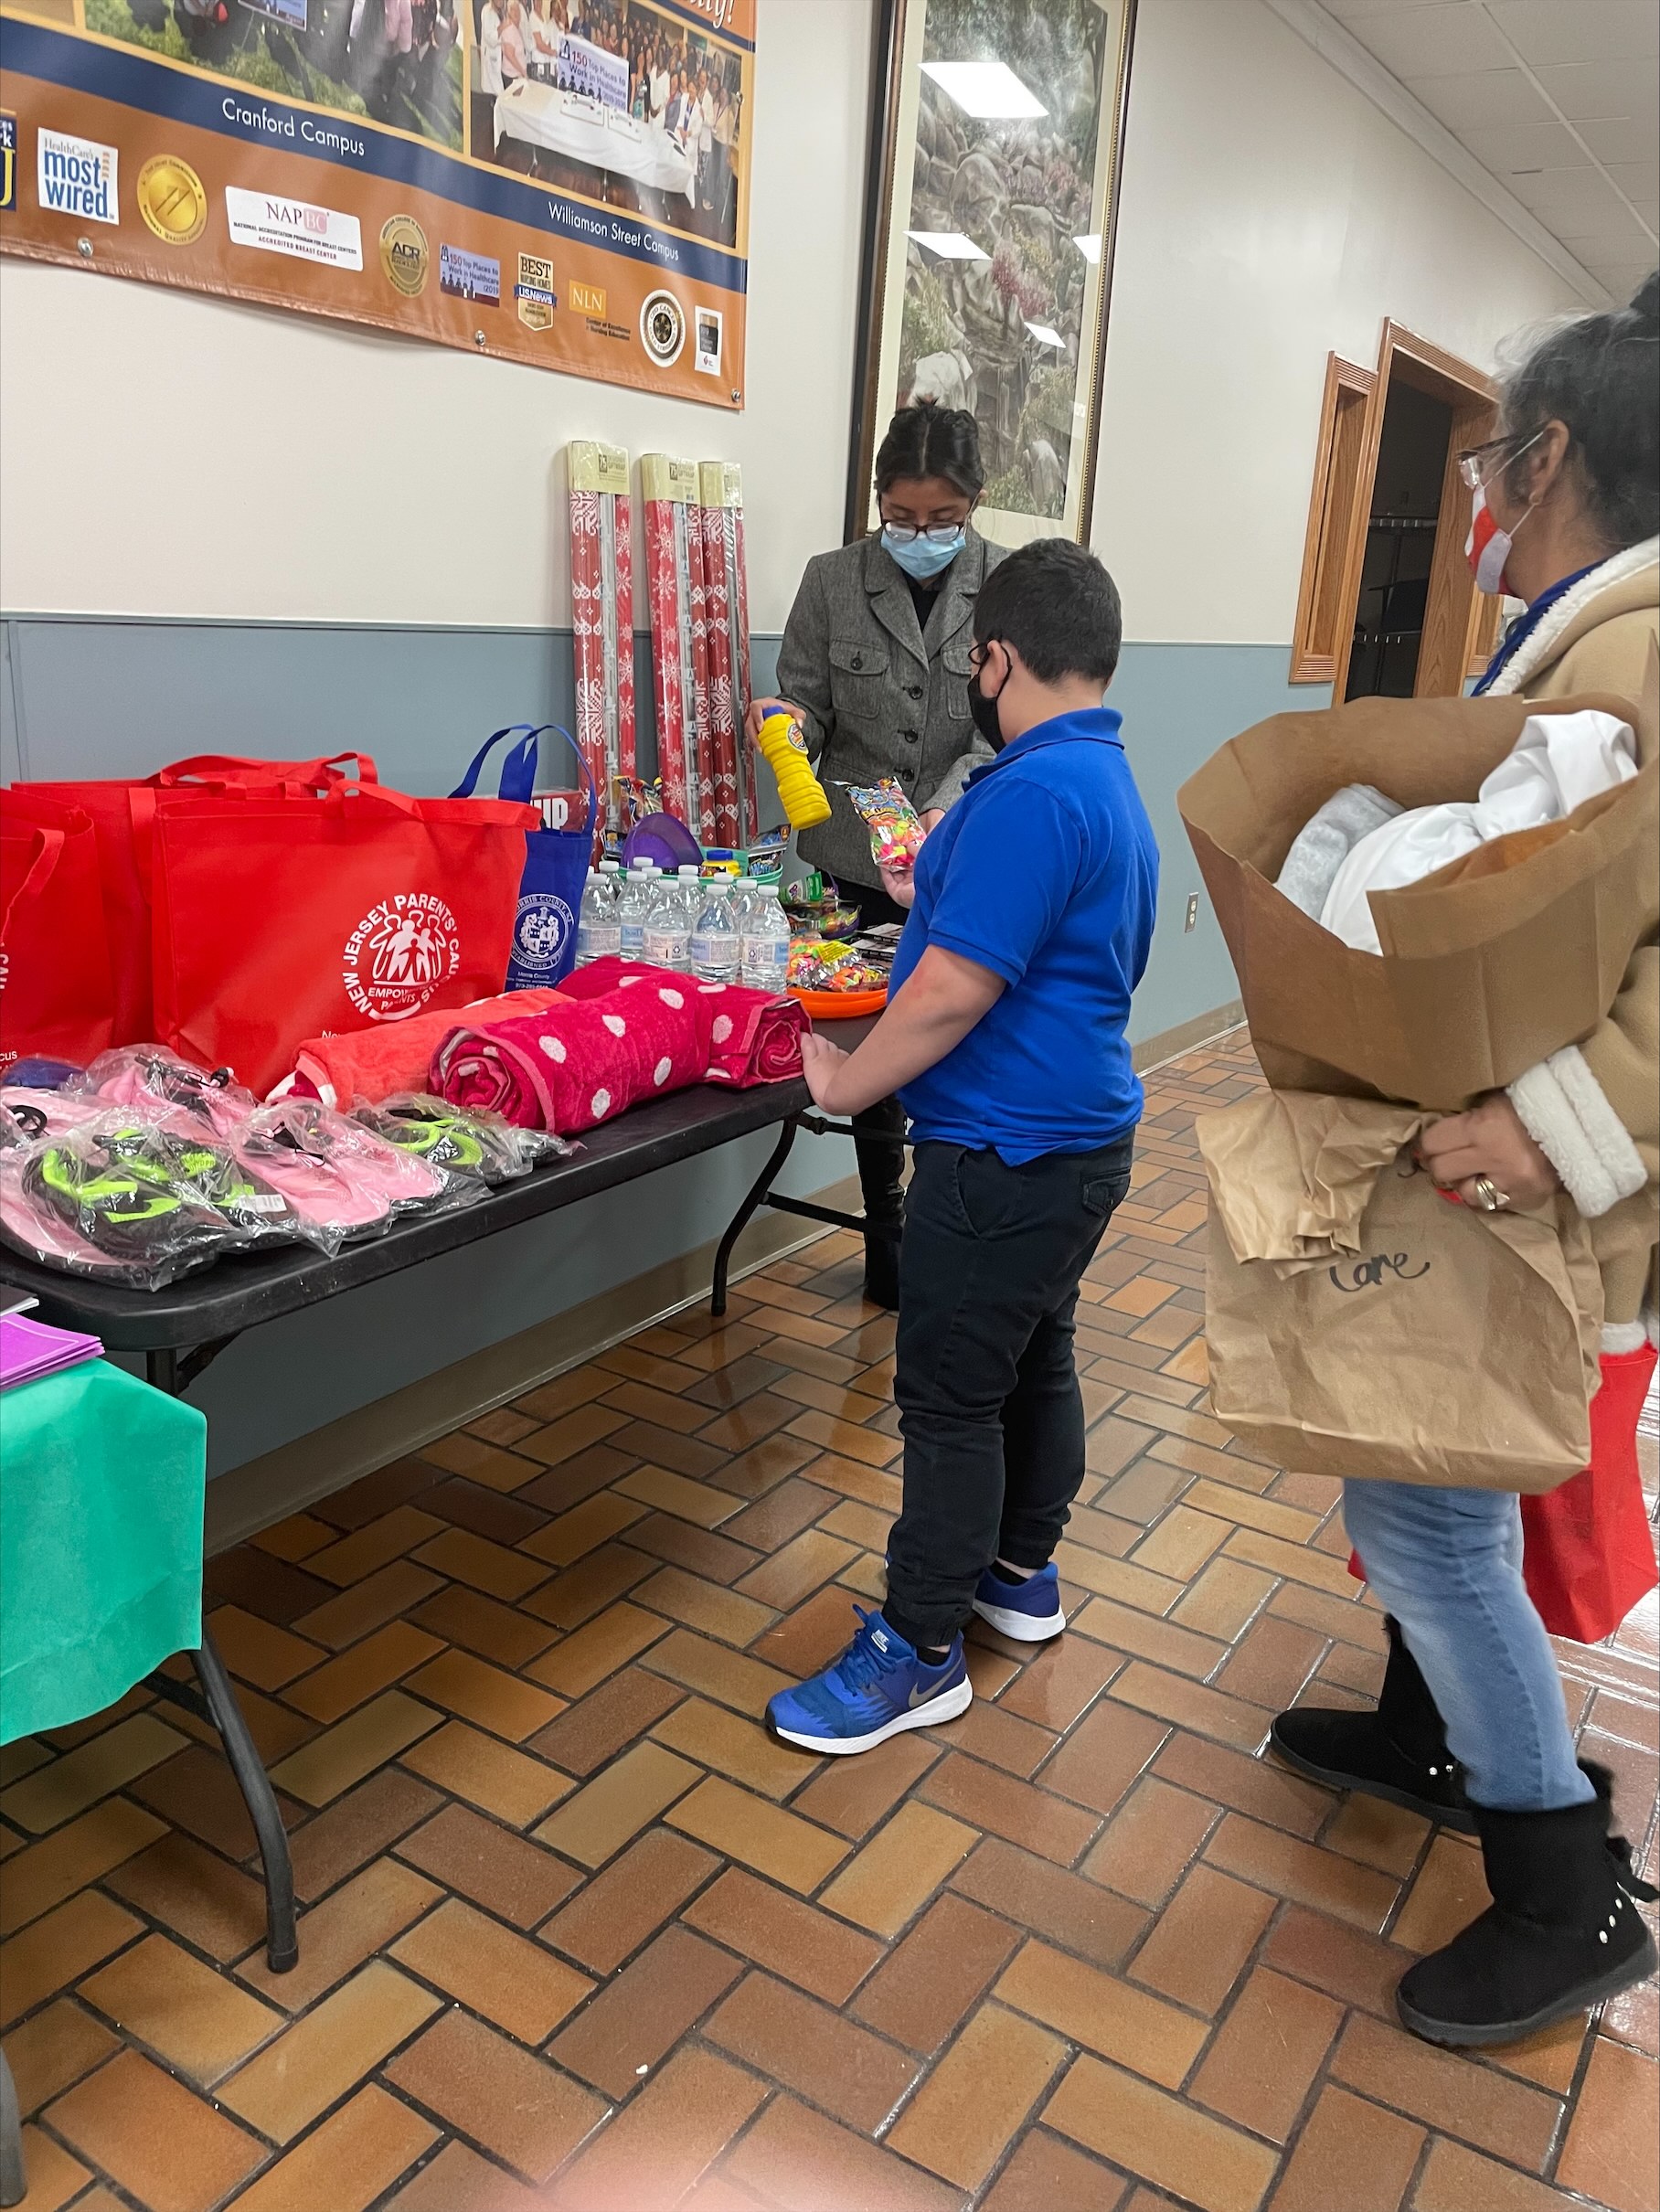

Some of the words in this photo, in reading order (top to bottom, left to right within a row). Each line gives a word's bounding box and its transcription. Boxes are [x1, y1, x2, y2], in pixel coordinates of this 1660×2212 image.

[569, 62, 588, 79] Work
[222, 98, 294, 137] Cranford
[301, 121, 365, 156] Campus
[44, 150, 101, 189] most
[45, 178, 108, 218] wired
[548, 201, 607, 237] Williamson
[611, 222, 641, 248] Street
[644, 233, 679, 261] Campus
[258, 235, 293, 250] ACCREDITED
[295, 243, 315, 256] BREAST
[316, 249, 337, 261] CENTER
[392, 241, 420, 261] ACR
[450, 253, 463, 266] 150
[448, 264, 463, 276] Work
[520, 256, 551, 279] BEST
[572, 287, 603, 313] NLN
[343, 900, 389, 966] JERSEY
[342, 972, 373, 1014] NEW
